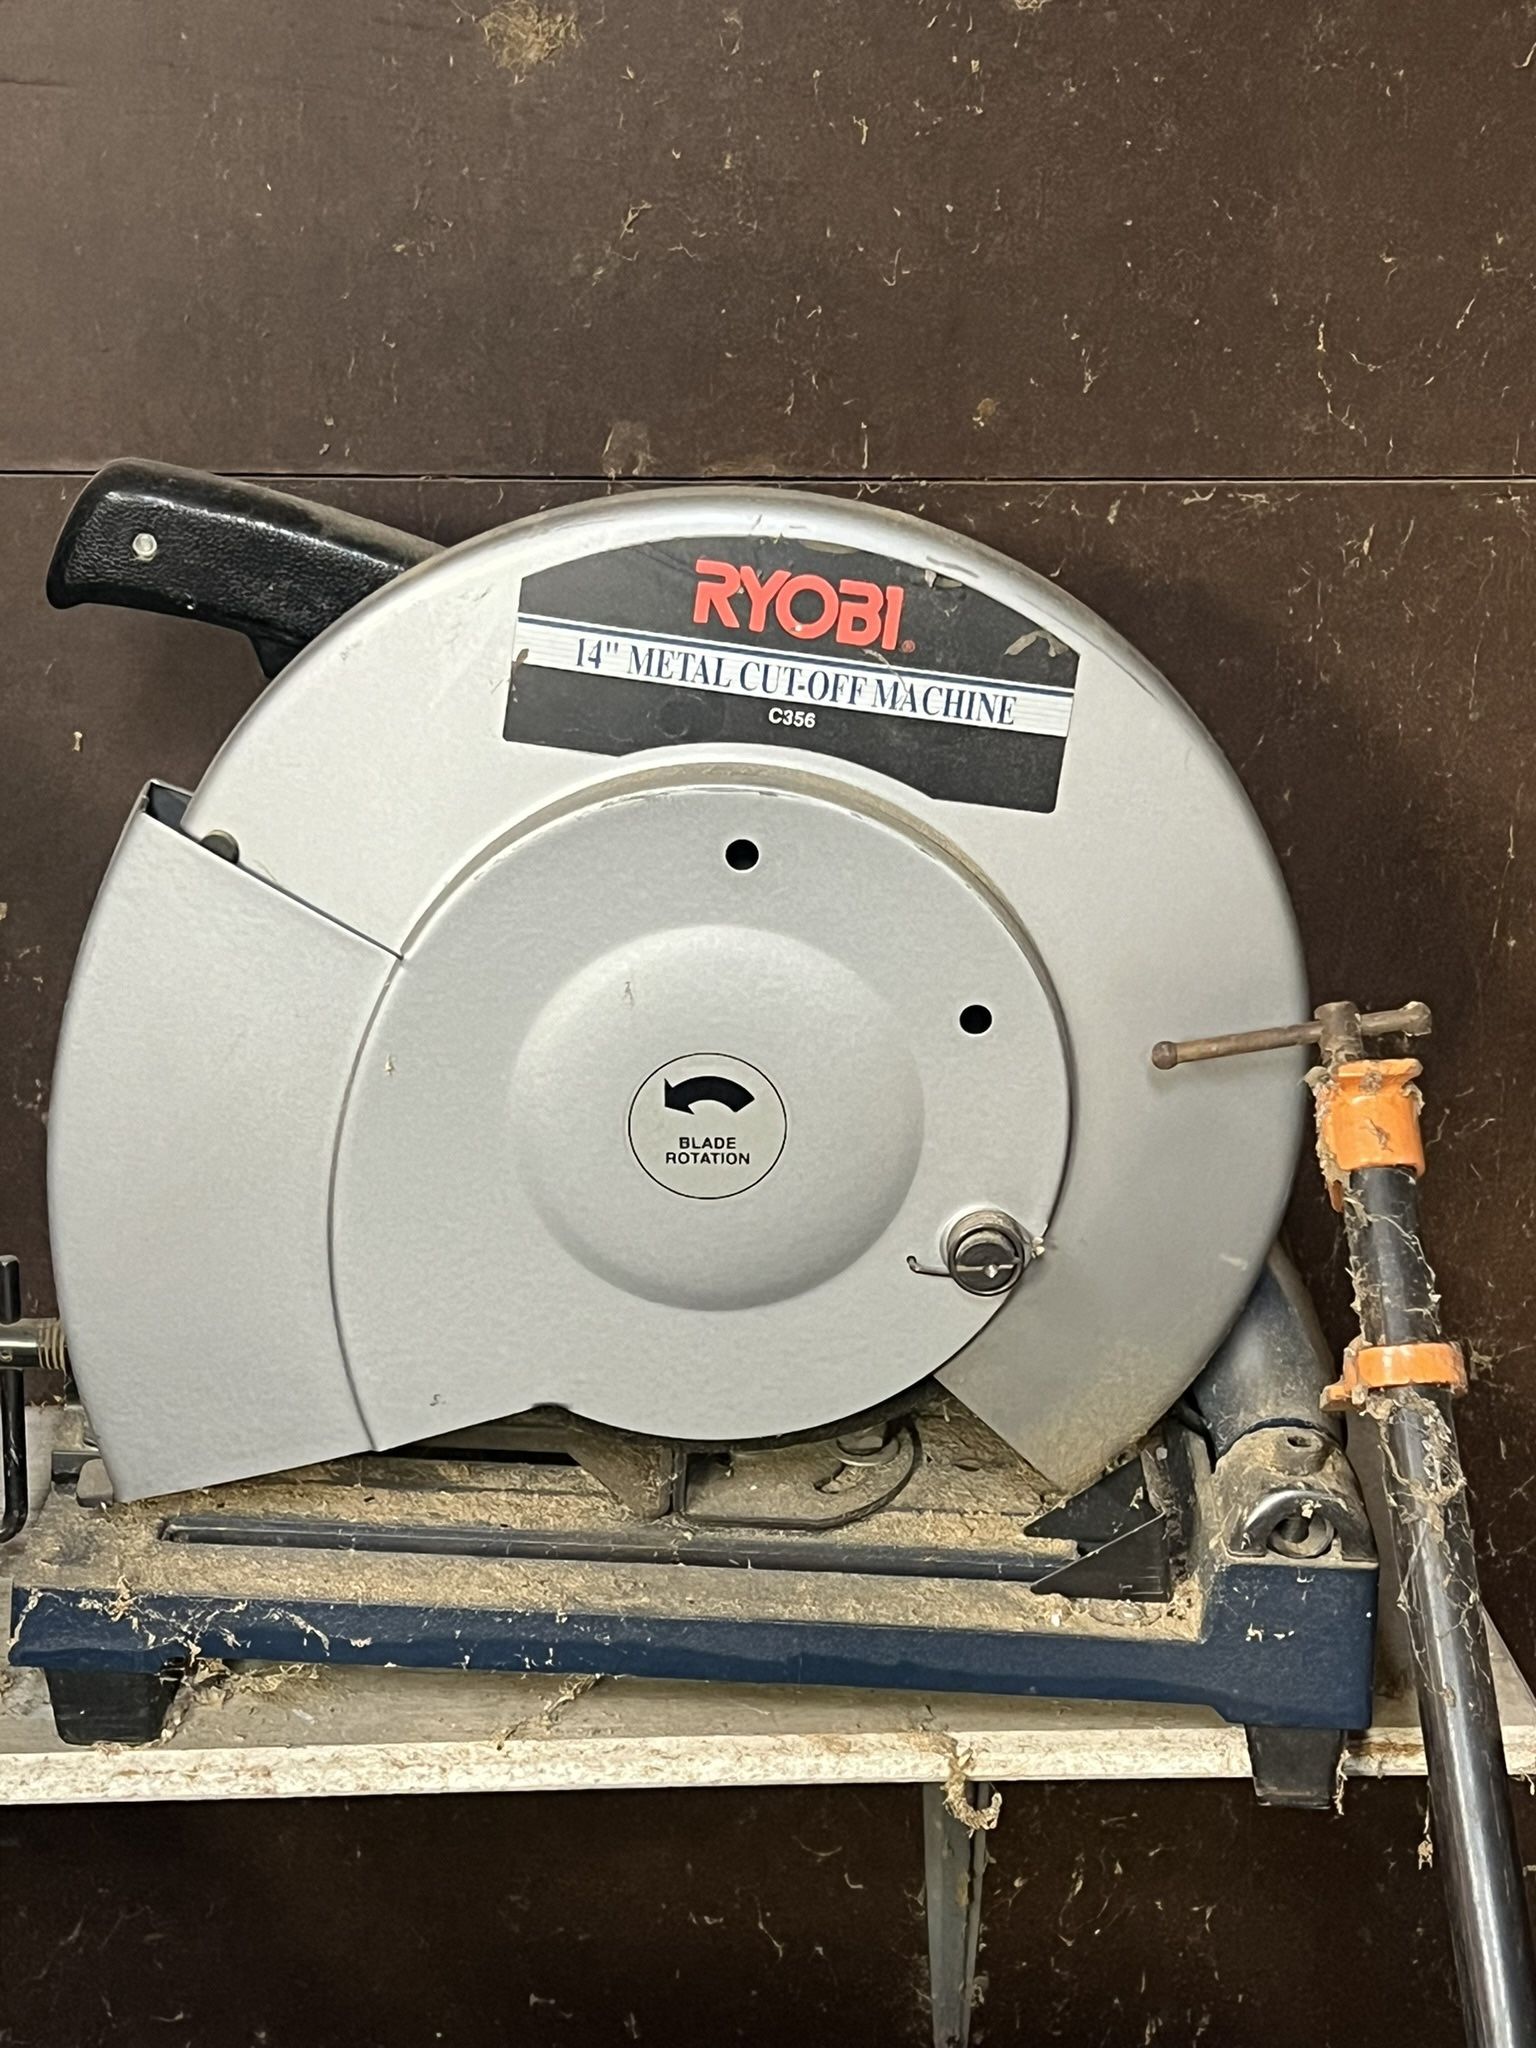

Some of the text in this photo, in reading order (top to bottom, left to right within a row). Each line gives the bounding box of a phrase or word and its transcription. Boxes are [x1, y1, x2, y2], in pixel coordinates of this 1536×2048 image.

[693, 559, 905, 650] RYOBI
[576, 637, 1018, 726] 14" METAL CUT-OFF MACHINE
[768, 707, 816, 729] C356
[679, 1137, 736, 1149] BLADE
[666, 1152, 750, 1165] ROTATION
